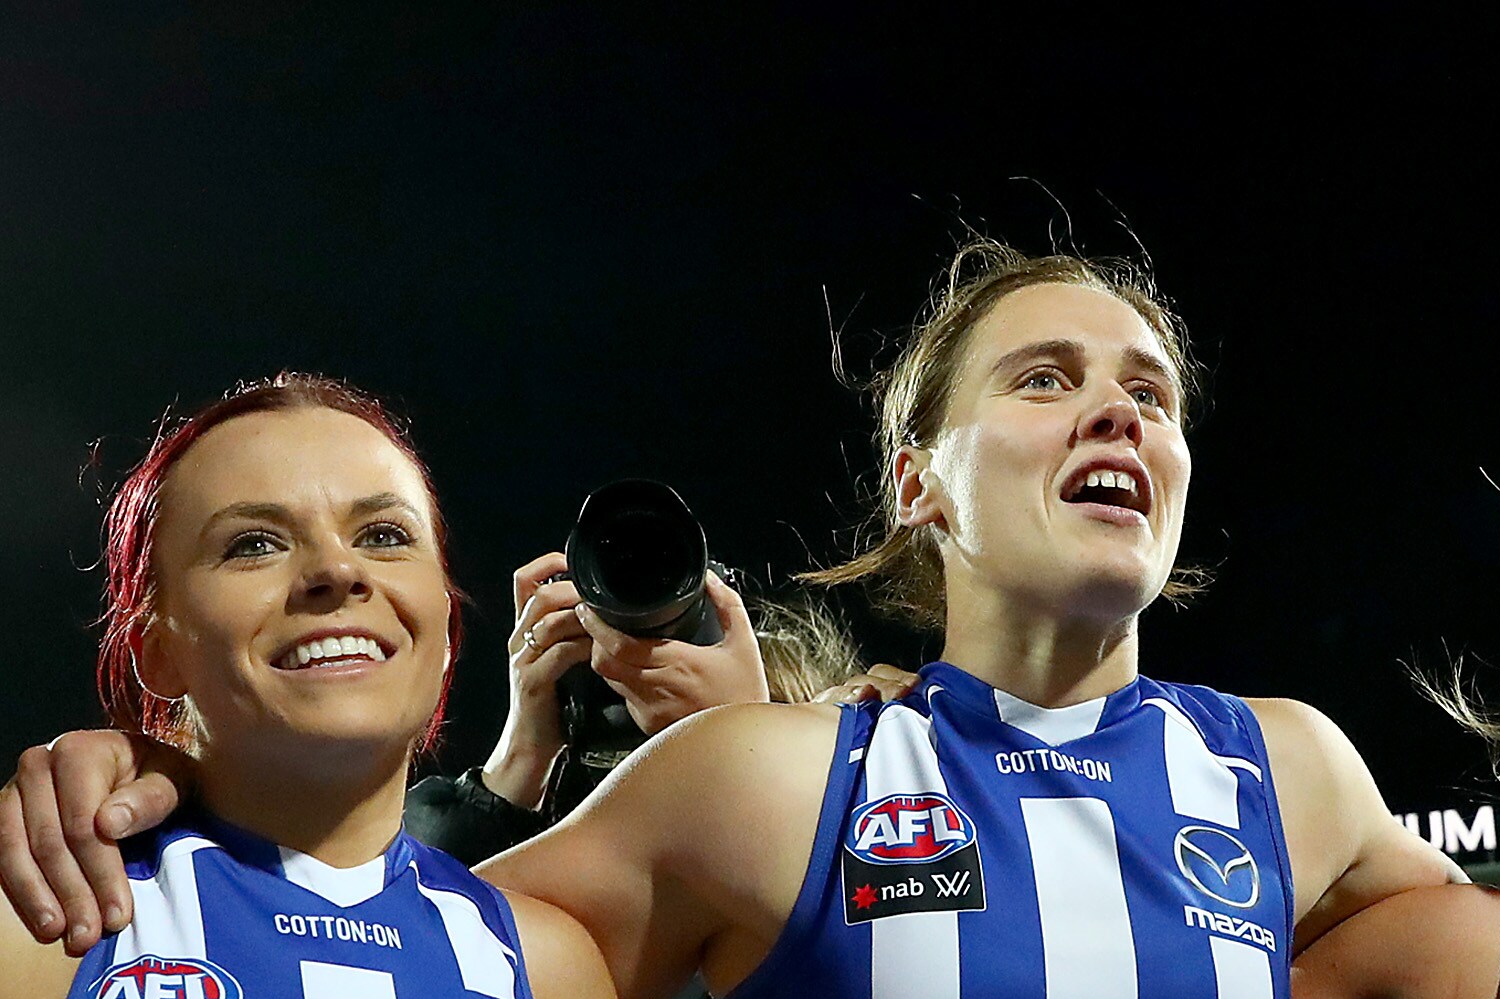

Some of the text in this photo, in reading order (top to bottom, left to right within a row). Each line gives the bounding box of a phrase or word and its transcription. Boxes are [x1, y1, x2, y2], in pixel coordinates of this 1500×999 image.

[996, 749, 1112, 782] COTTON:ON
[855, 808, 966, 851] AFL
[881, 878, 924, 900] nab
[275, 914, 403, 949] COTTON:ON
[1184, 906, 1277, 952] mazda
